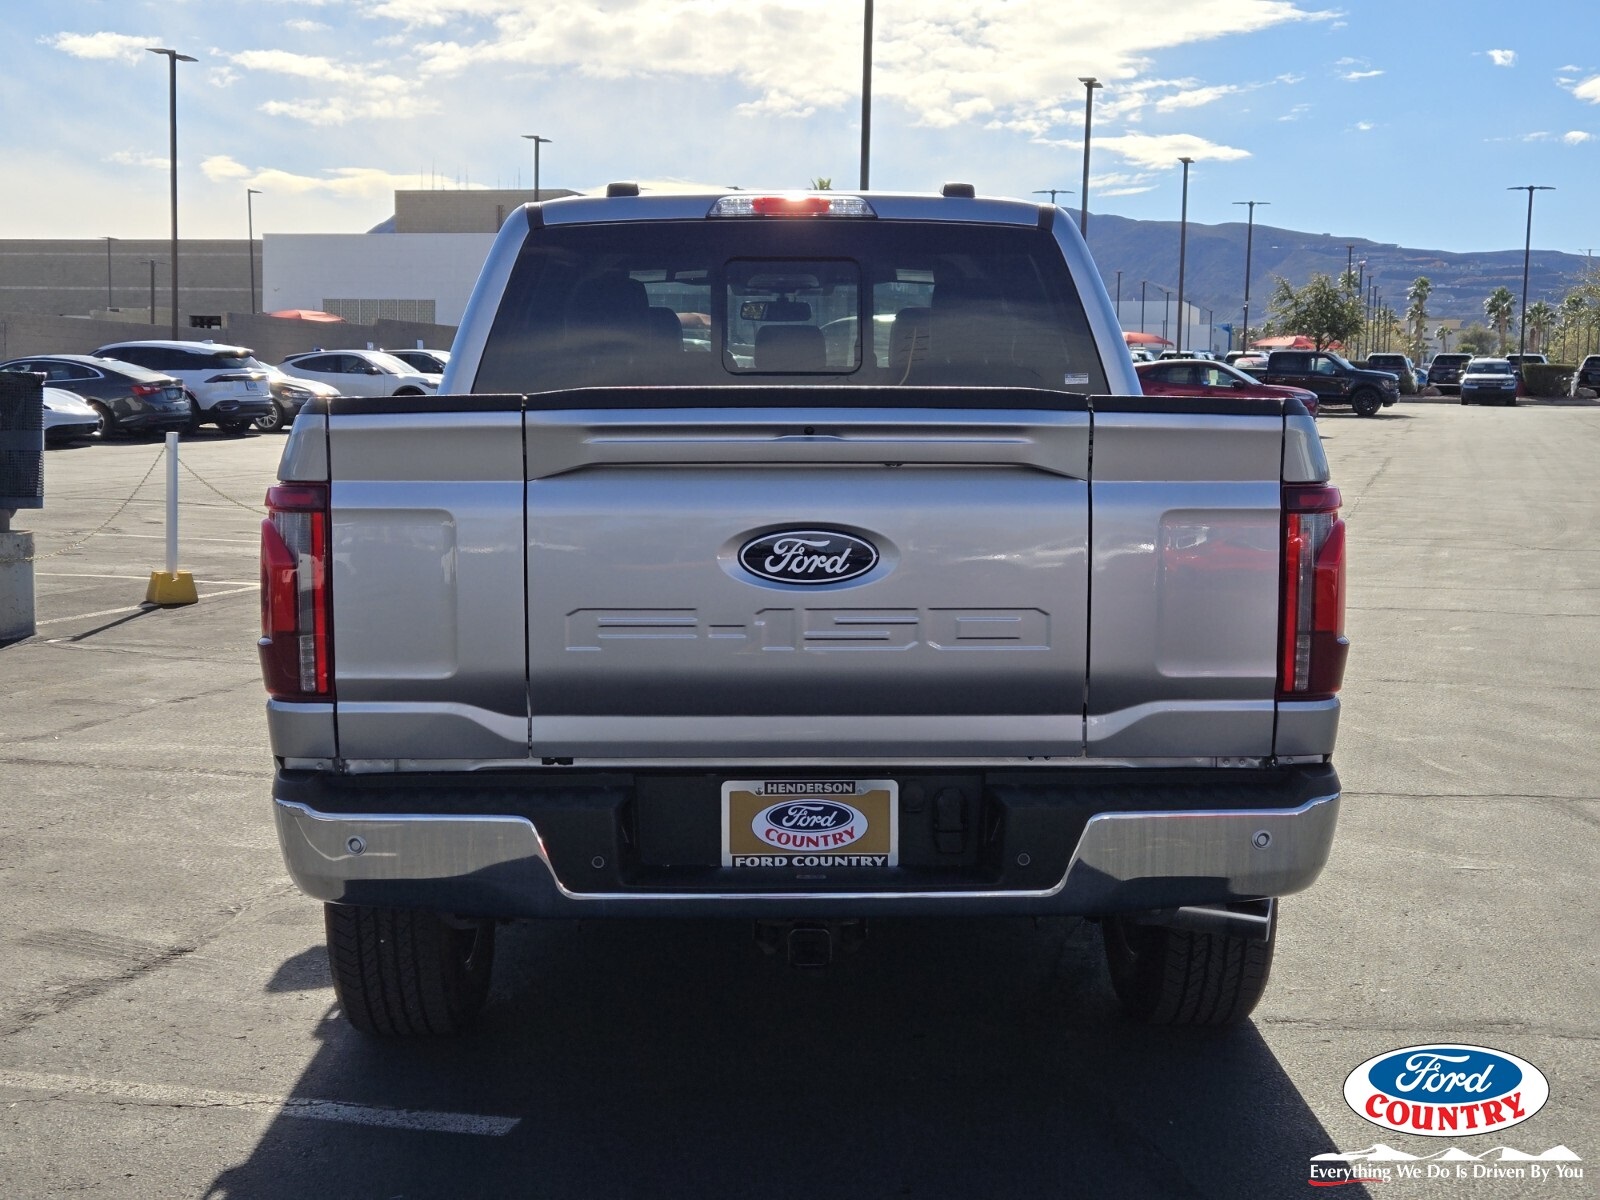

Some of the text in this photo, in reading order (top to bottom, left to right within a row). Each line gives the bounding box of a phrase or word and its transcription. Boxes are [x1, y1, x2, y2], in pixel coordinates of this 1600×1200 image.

[764, 537, 852, 575] Ford
[565, 607, 1051, 652] F-150
[767, 783, 853, 794] HENDERSON
[781, 805, 838, 828] Ford
[765, 826, 856, 848] COUNTRY
[735, 856, 886, 867] FORD COUNTRY
